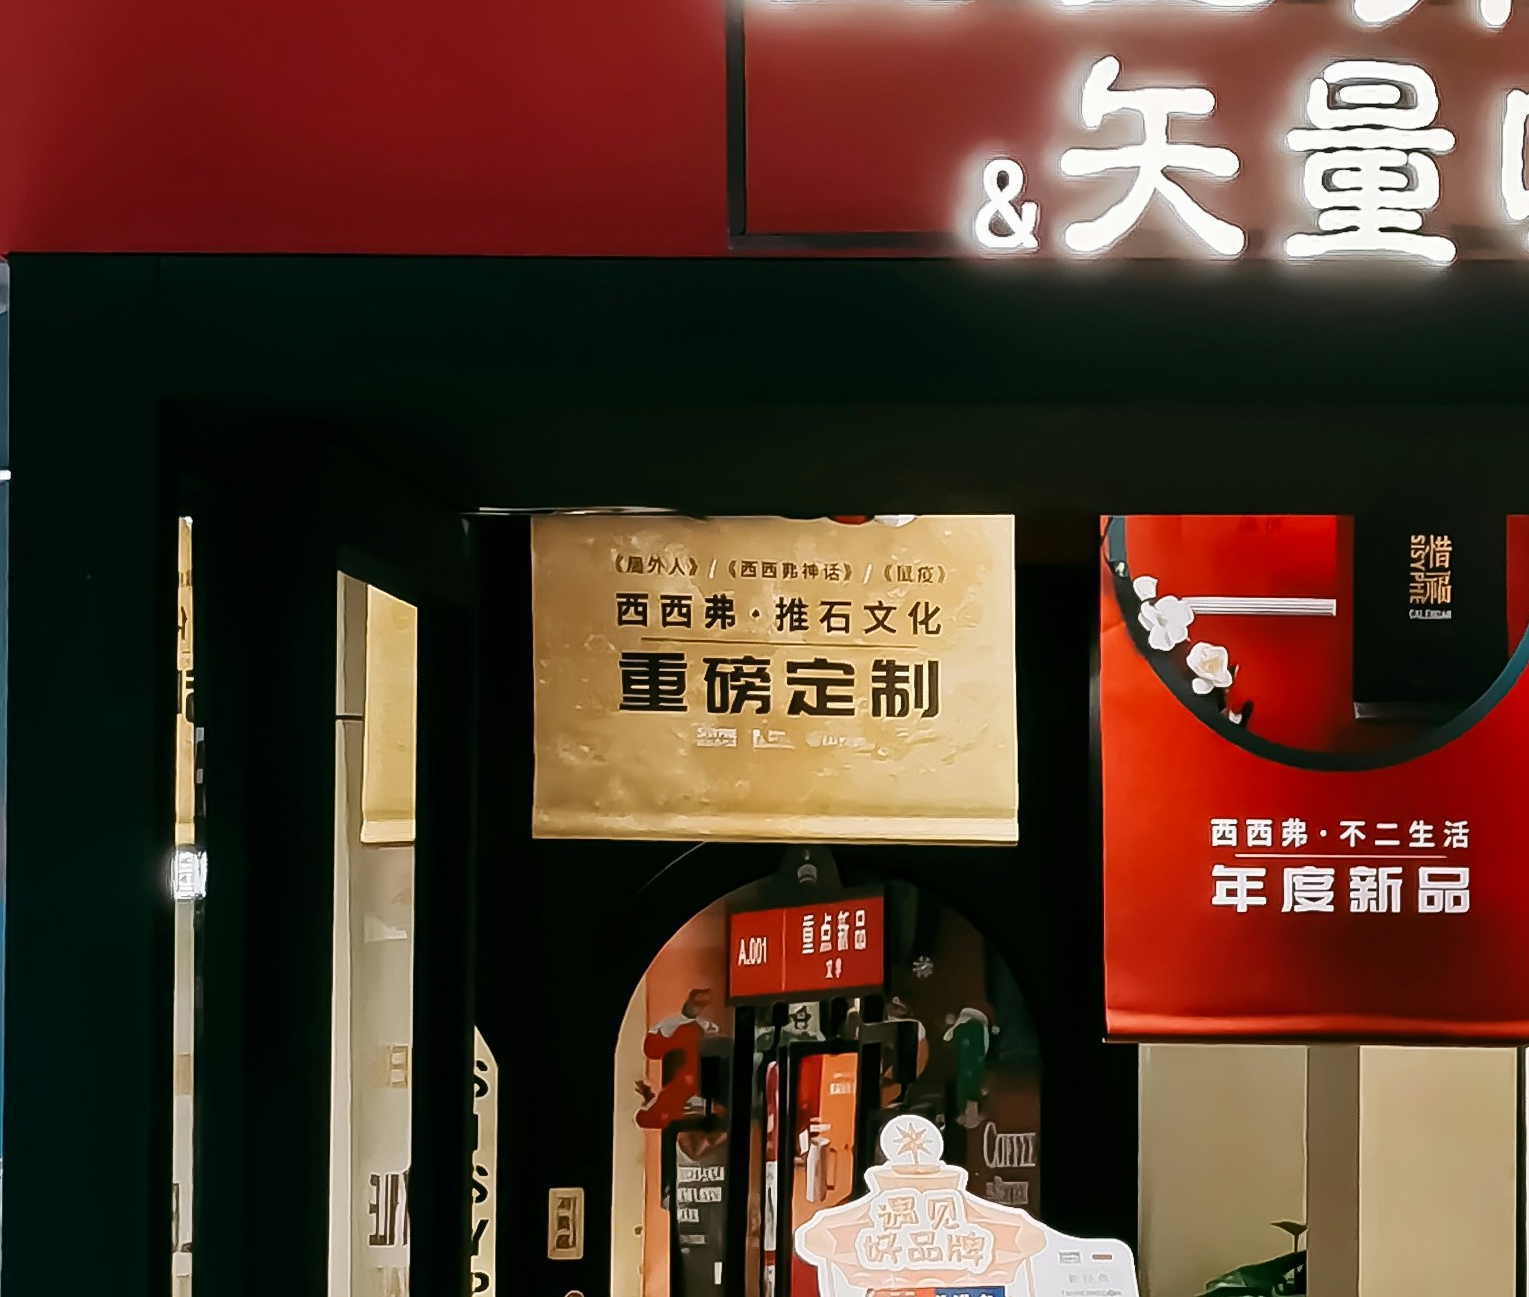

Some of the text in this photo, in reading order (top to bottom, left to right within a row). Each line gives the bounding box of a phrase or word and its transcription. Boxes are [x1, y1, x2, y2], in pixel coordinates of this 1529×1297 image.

[619, 651, 940, 719] 重磅定制
[1210, 864, 1471, 914] 年度新品
[801, 909, 867, 955] 重点新品
